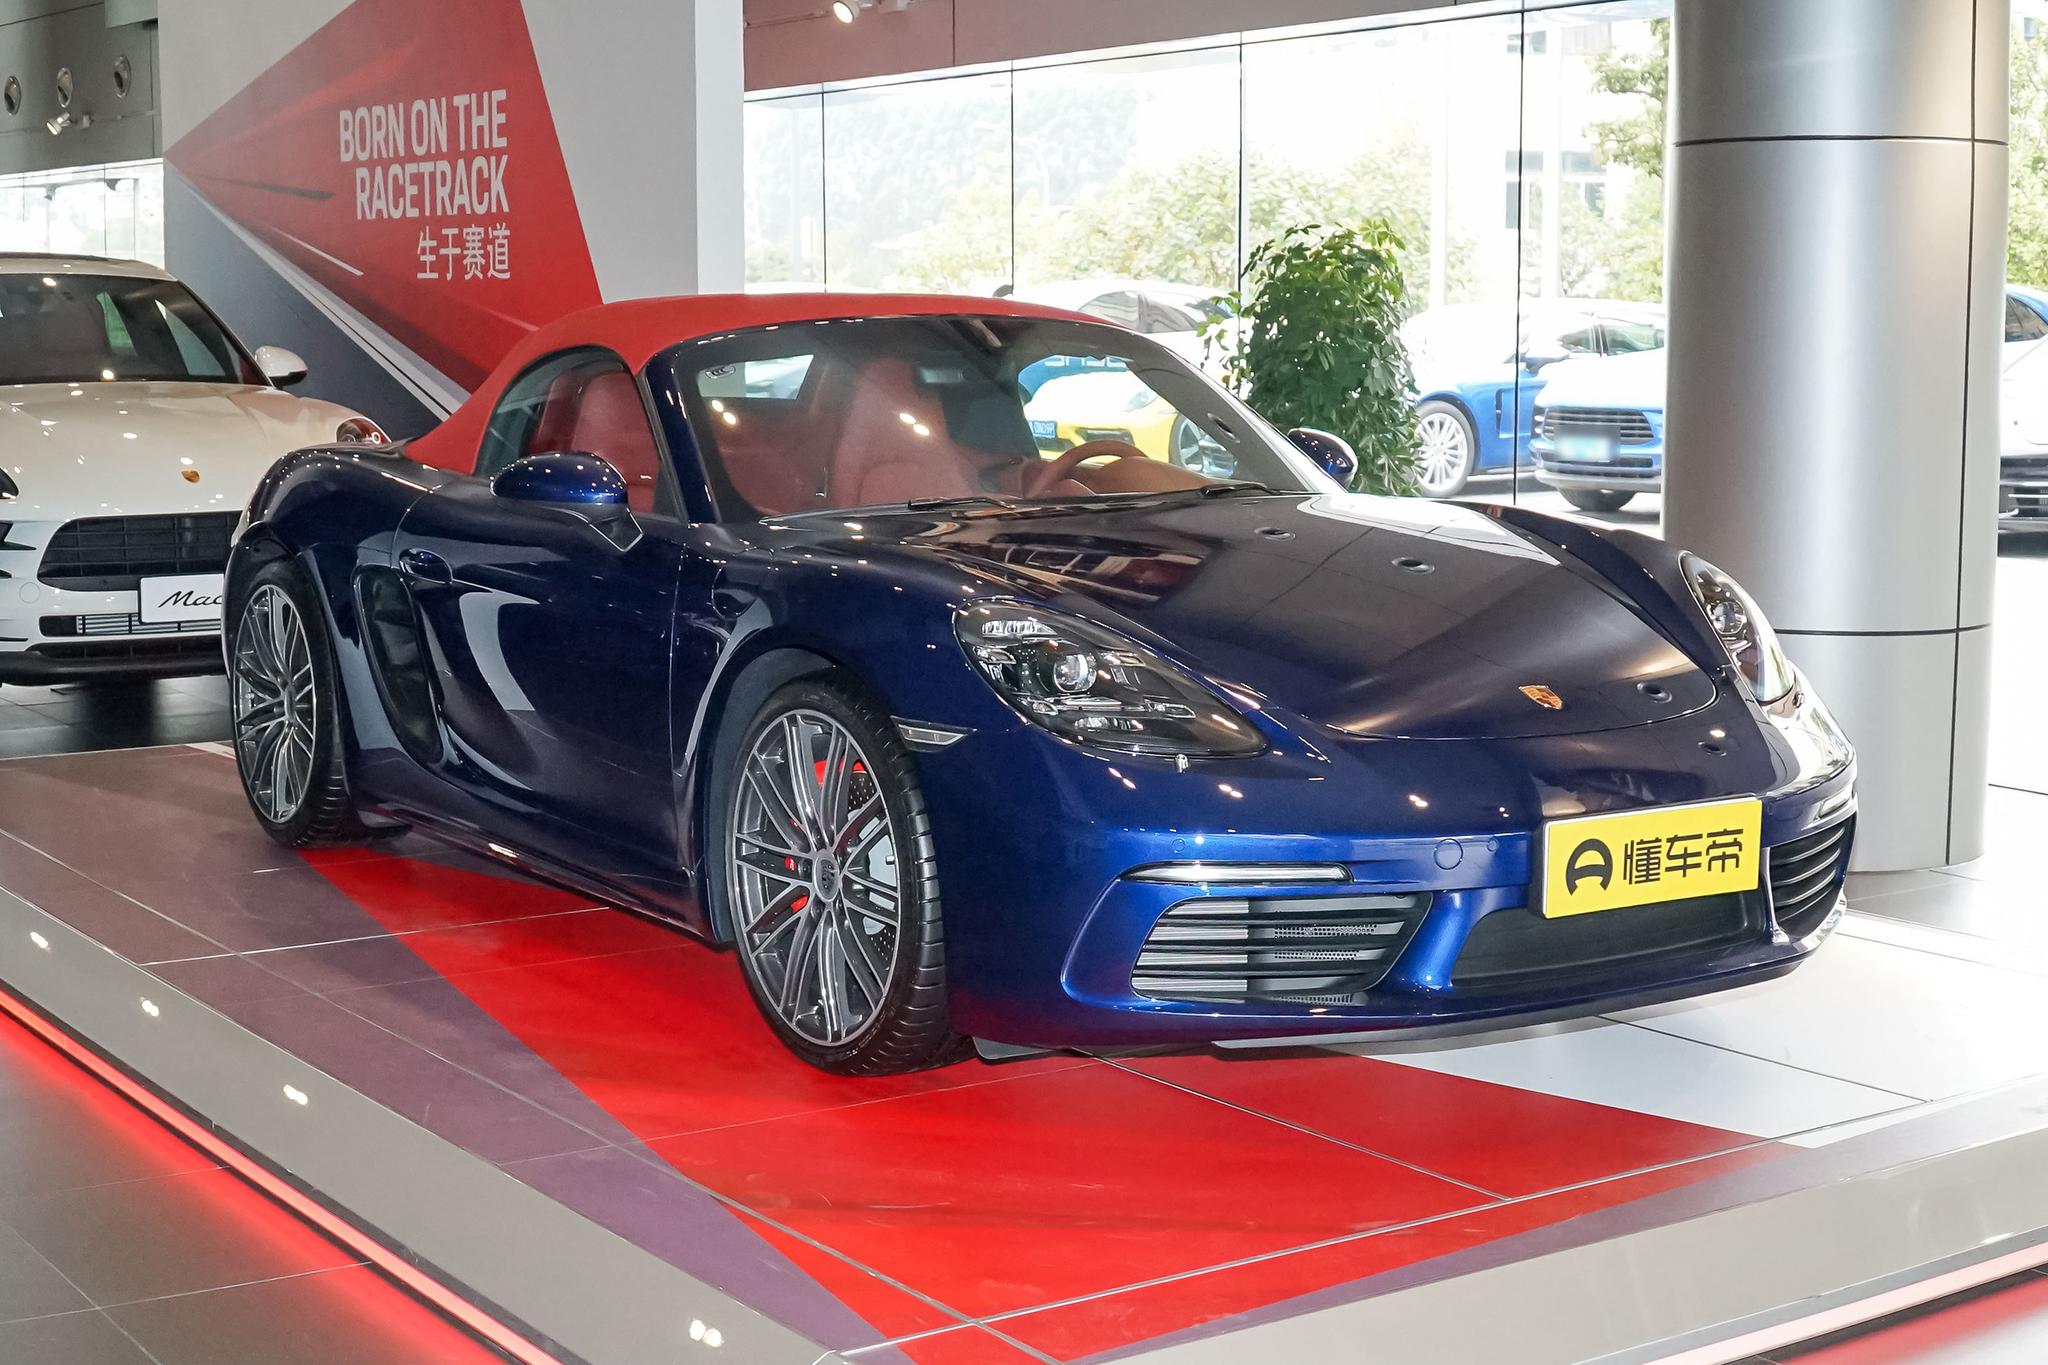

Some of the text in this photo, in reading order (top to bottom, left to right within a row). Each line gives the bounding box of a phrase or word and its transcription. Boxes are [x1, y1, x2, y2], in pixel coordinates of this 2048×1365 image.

[339, 89, 508, 162] BORN ON THE
[355, 154, 510, 221] RACETRACK
[416, 222, 511, 281] 生于赛道
[1622, 828, 1744, 885] 懂车帝
